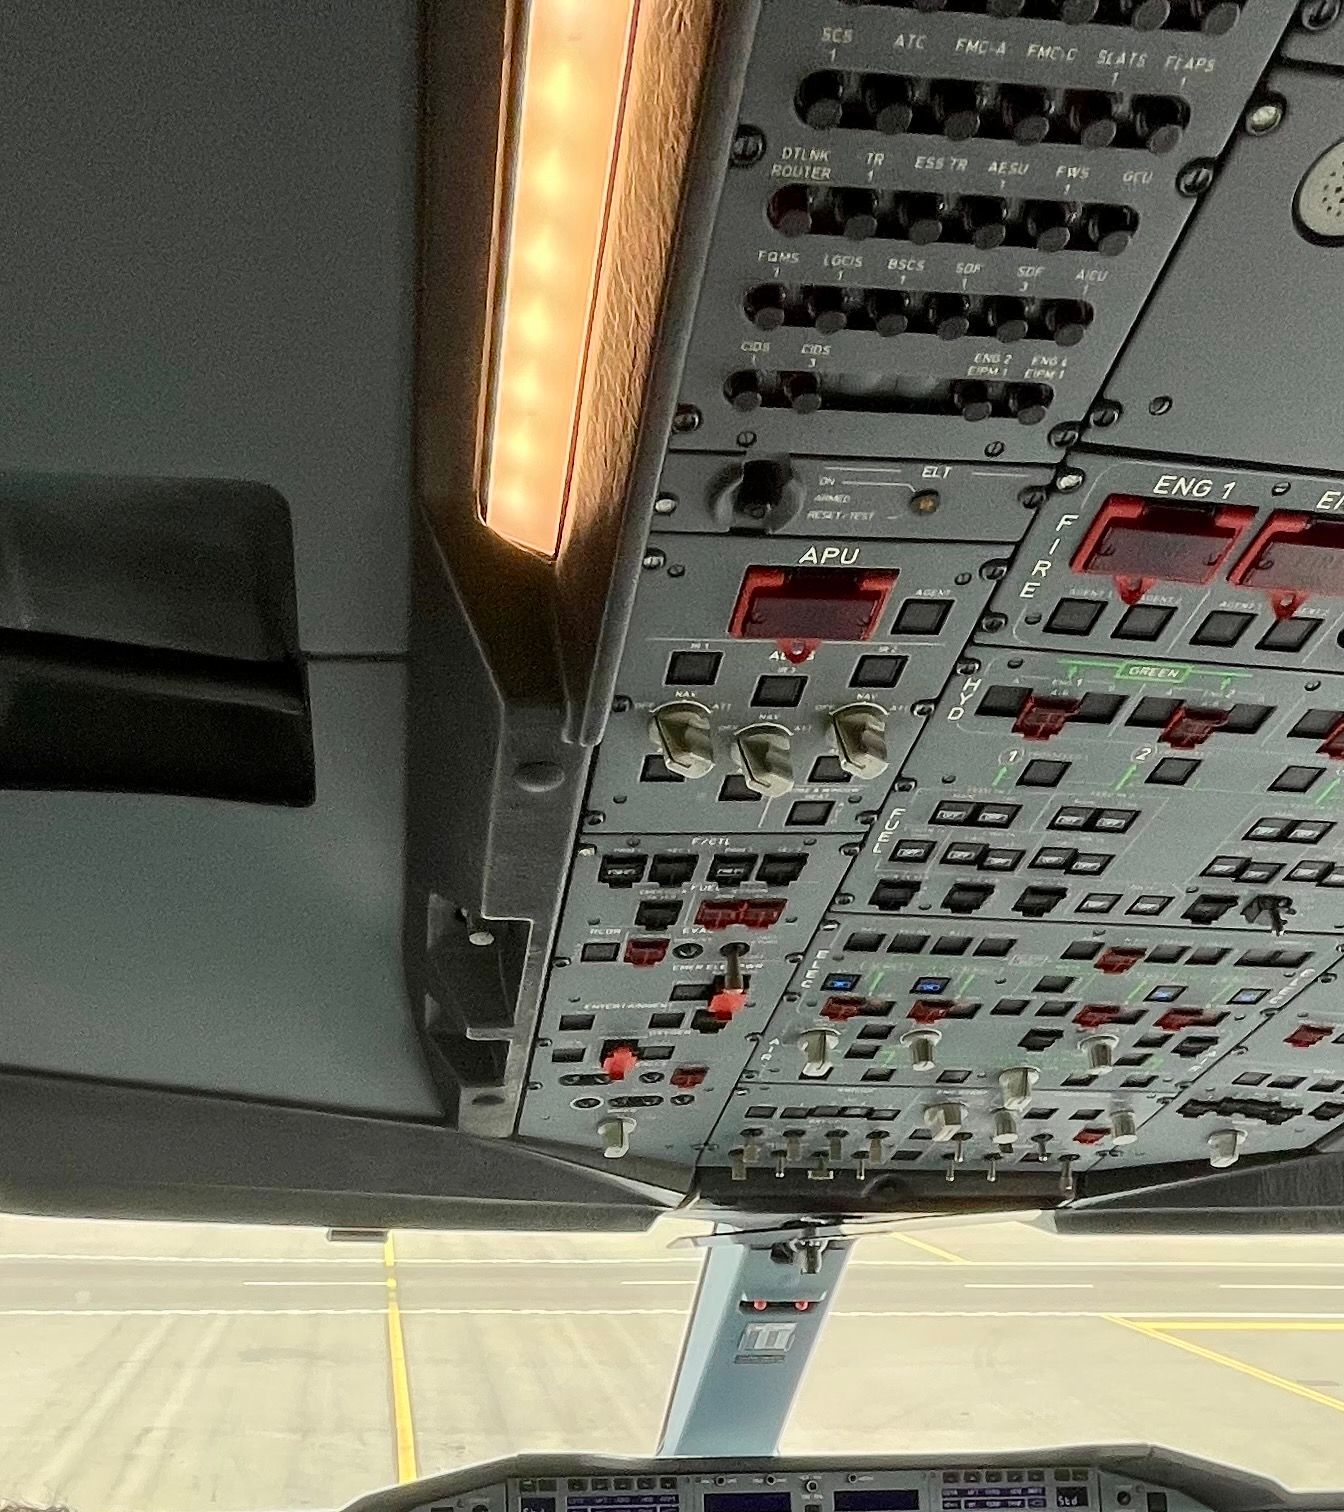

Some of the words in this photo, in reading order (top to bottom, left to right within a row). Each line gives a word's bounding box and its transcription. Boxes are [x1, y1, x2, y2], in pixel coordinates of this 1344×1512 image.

[821, 27, 853, 44] SCS
[893, 33, 926, 50] ATC
[769, 163, 832, 181] ROUTER
[914, 156, 944, 171] ESS
[921, 465, 952, 479] ELT
[1152, 474, 1215, 498] ENG
[1221, 480, 1238, 498] 1
[798, 546, 861, 565] APU
[1017, 512, 1081, 602] FIRE
[1128, 665, 1181, 679] GREEN
[947, 677, 983, 721] HYD
[872, 807, 907, 855] FUEL
